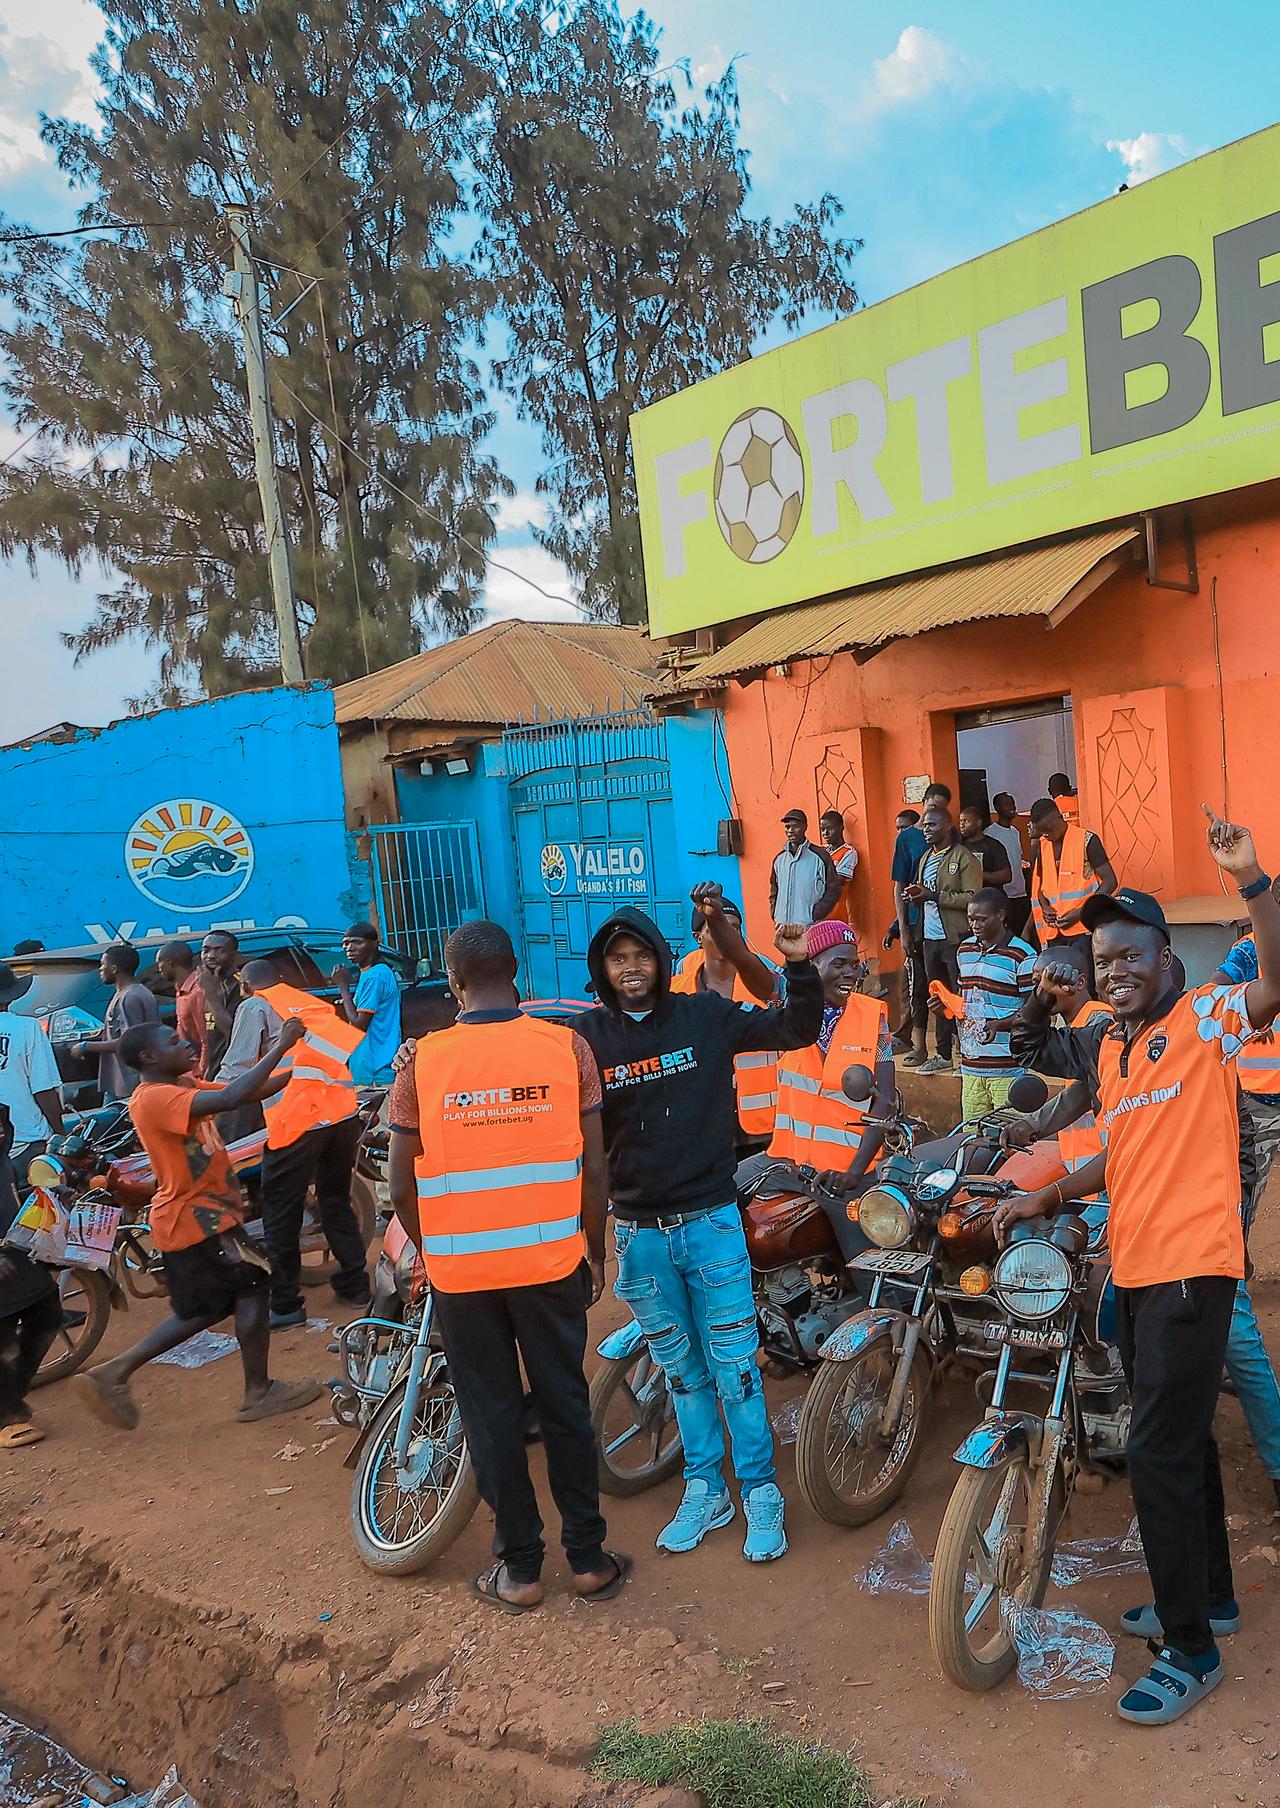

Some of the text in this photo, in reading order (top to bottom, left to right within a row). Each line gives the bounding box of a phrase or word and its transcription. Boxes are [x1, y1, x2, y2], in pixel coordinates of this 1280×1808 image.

[569, 843, 645, 876] YALELO
[615, 879, 625, 893] #1
[603, 1046, 694, 1083] FORTEBET
[606, 1081, 624, 1091] PLAY
[625, 1077, 641, 1086] FOR
[678, 1060, 698, 1073] NOW!
[443, 1085, 550, 1109] FORTEBET
[443, 1103, 553, 1121] PLAY FOR BILLIONS NOW!
[462, 1115, 533, 1128] www.fortebet.ug
[885, 1251, 923, 1264] UET
